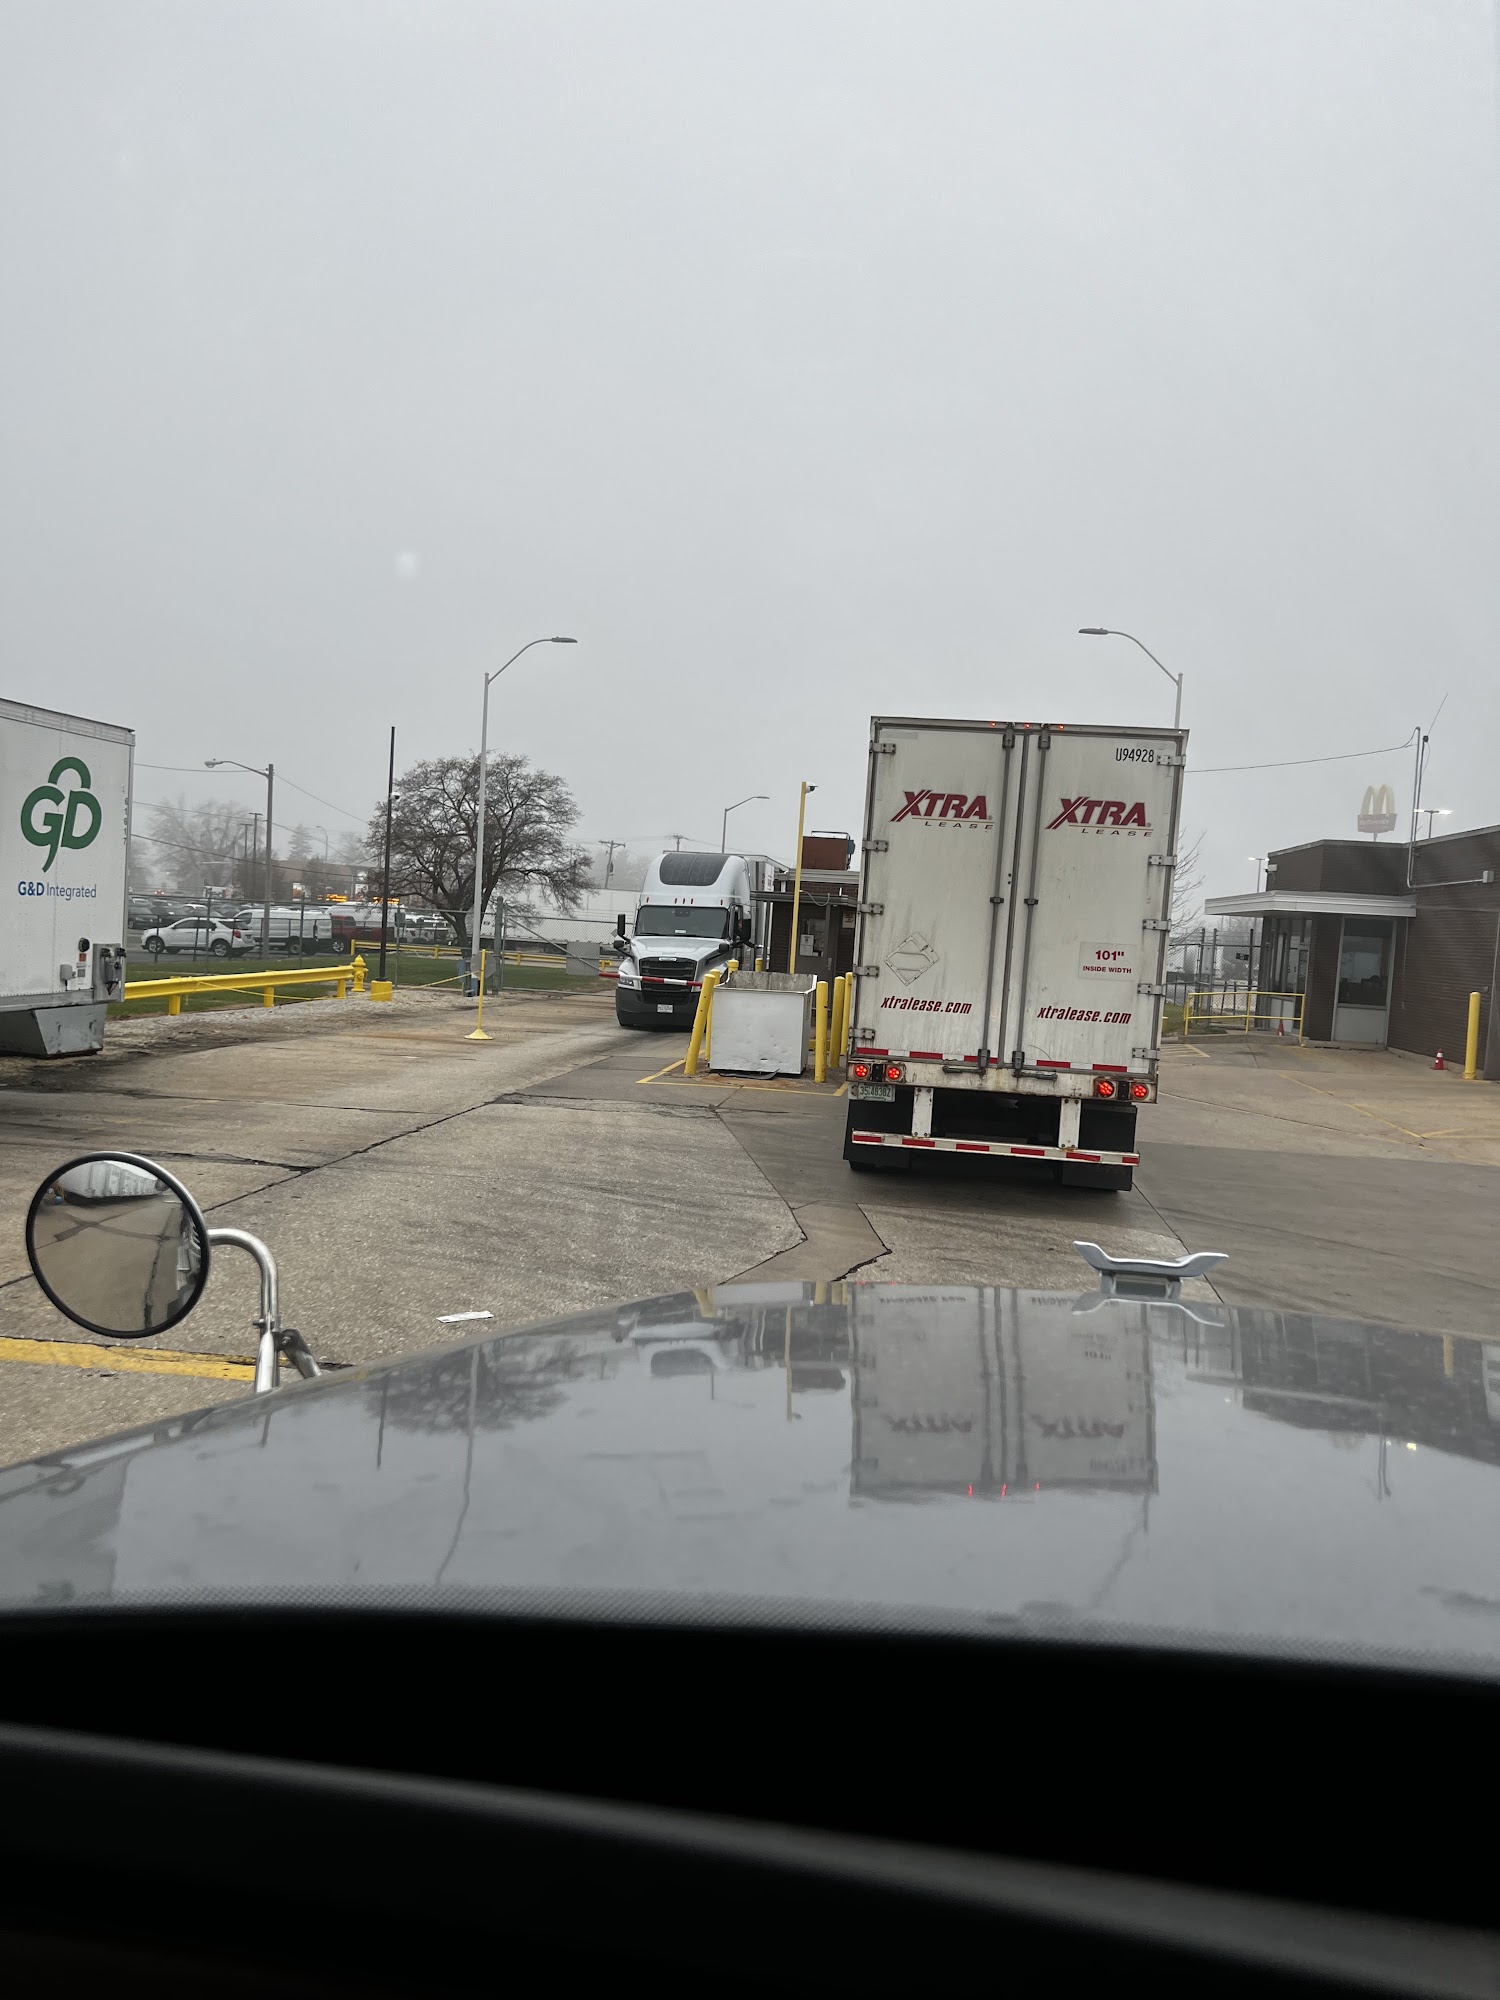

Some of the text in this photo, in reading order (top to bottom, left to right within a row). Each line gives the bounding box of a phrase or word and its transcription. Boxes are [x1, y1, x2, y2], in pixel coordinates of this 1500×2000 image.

[1115, 747, 1154, 763] U94928
[889, 789, 987, 822] XTRA
[1045, 796, 1146, 830] XTRA
[924, 821, 994, 830] LEASE
[1081, 828, 1153, 838] LEASE
[18, 880, 97, 901] G&D Integrated
[1095, 949, 1125, 961] 101"
[1082, 965, 1107, 973] INSIDE
[880, 995, 973, 1015] xtralease.com
[1036, 1005, 1132, 1025] xtralease.com
